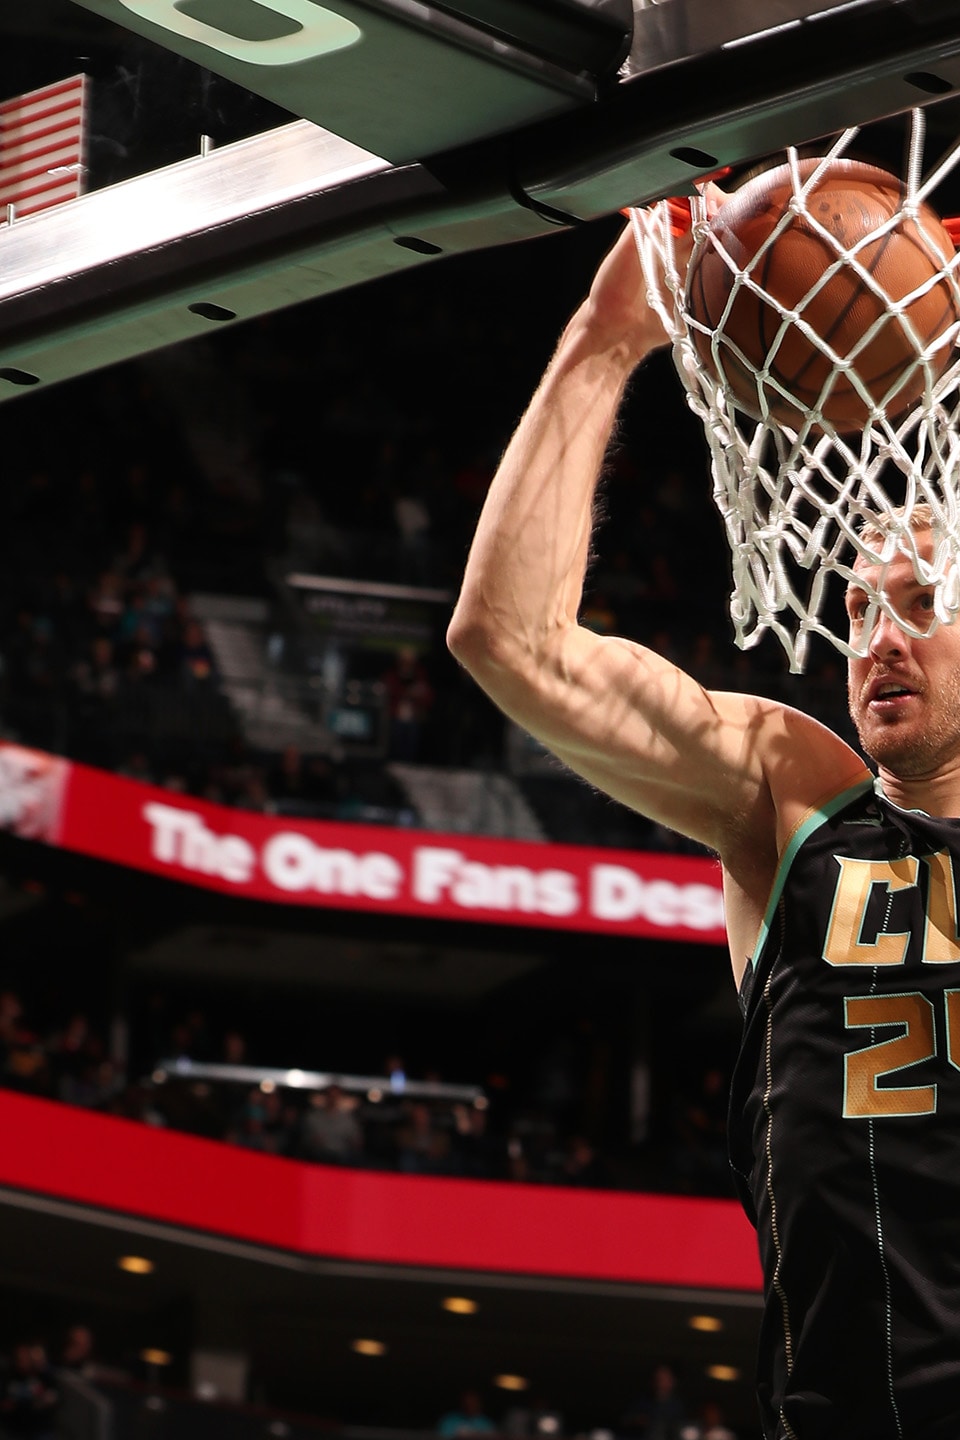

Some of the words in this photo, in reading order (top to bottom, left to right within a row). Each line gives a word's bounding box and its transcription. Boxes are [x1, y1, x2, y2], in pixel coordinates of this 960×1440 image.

[143, 802, 255, 884] The
[262, 831, 402, 899] One
[414, 846, 579, 917] Fans
